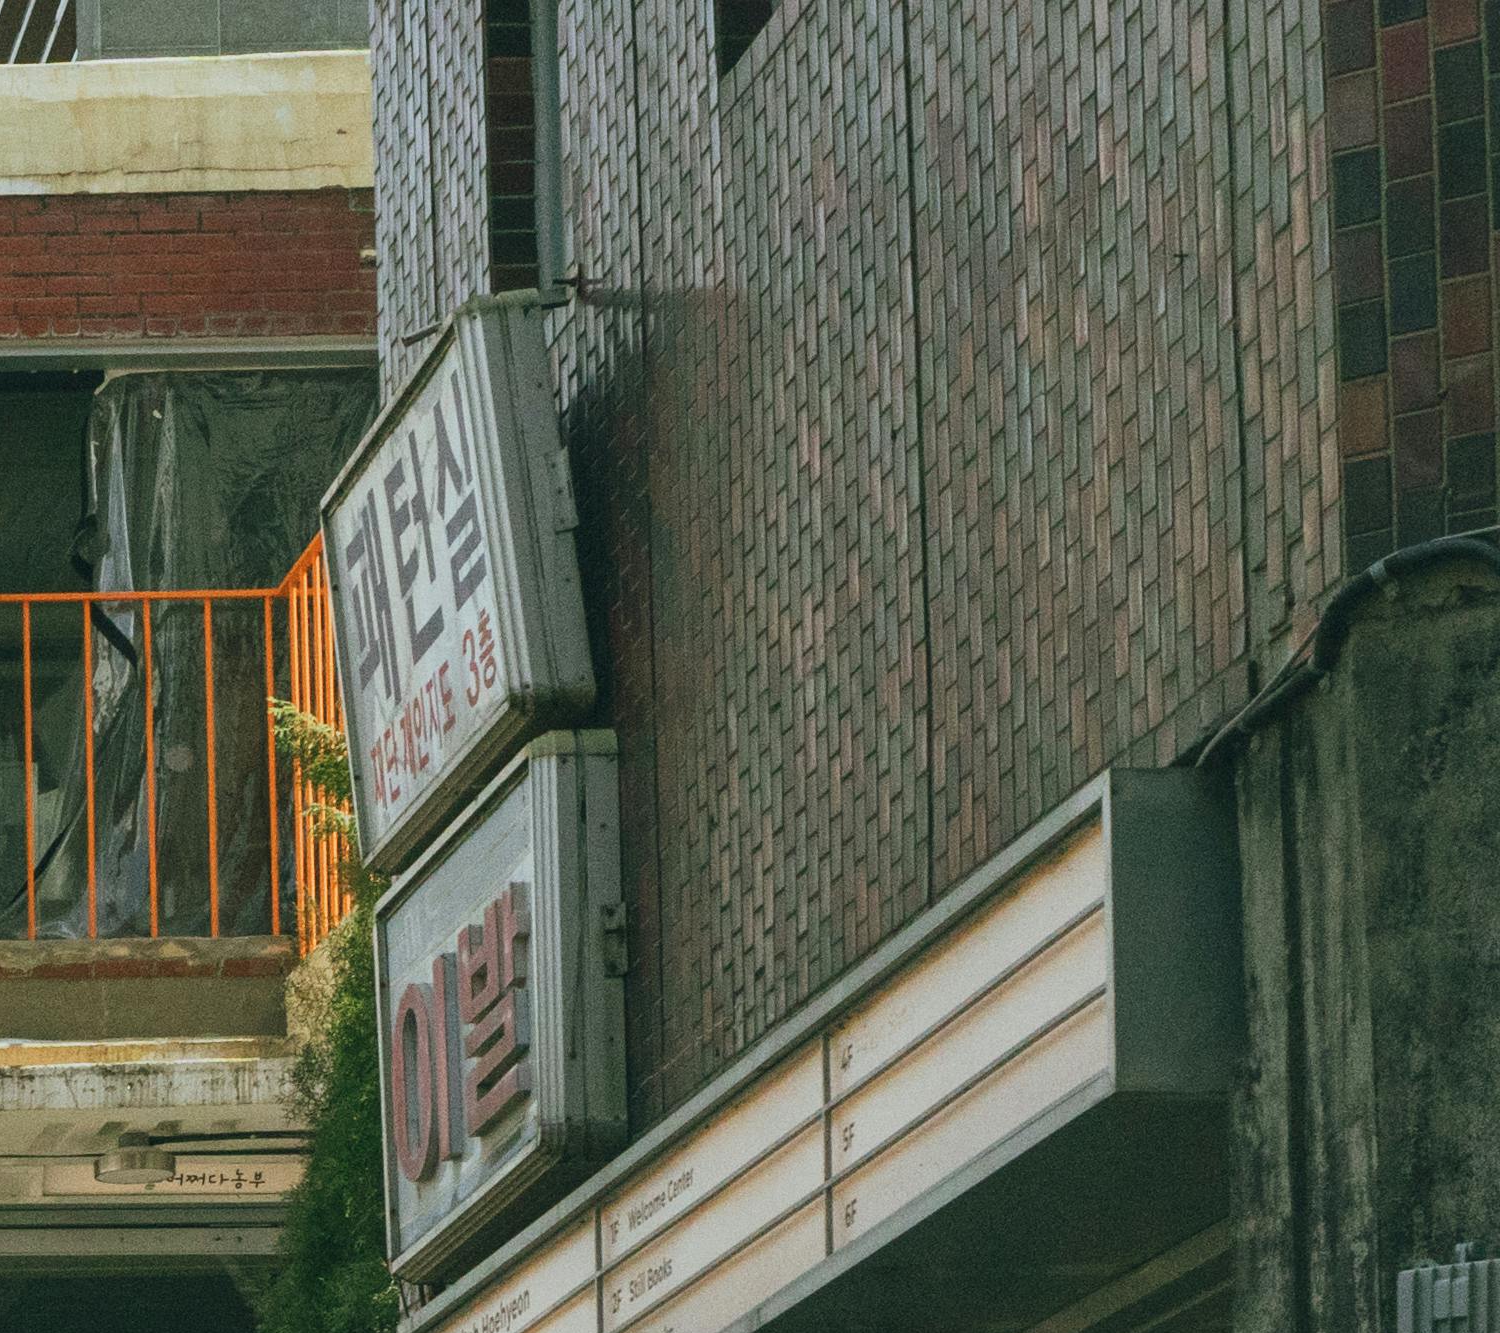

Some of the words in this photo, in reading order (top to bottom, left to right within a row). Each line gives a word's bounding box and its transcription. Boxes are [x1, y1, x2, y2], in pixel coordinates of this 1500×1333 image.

[345, 369, 487, 700] 패턴실
[392, 883, 525, 1182] 이발
[843, 1122, 855, 1152] 5F
[627, 1191, 667, 1232] Welcome
[667, 1168, 695, 1211] Center
[844, 1198, 857, 1228] 6F
[628, 1275, 648, 1303] Still
[648, 1257, 674, 1293] Books
